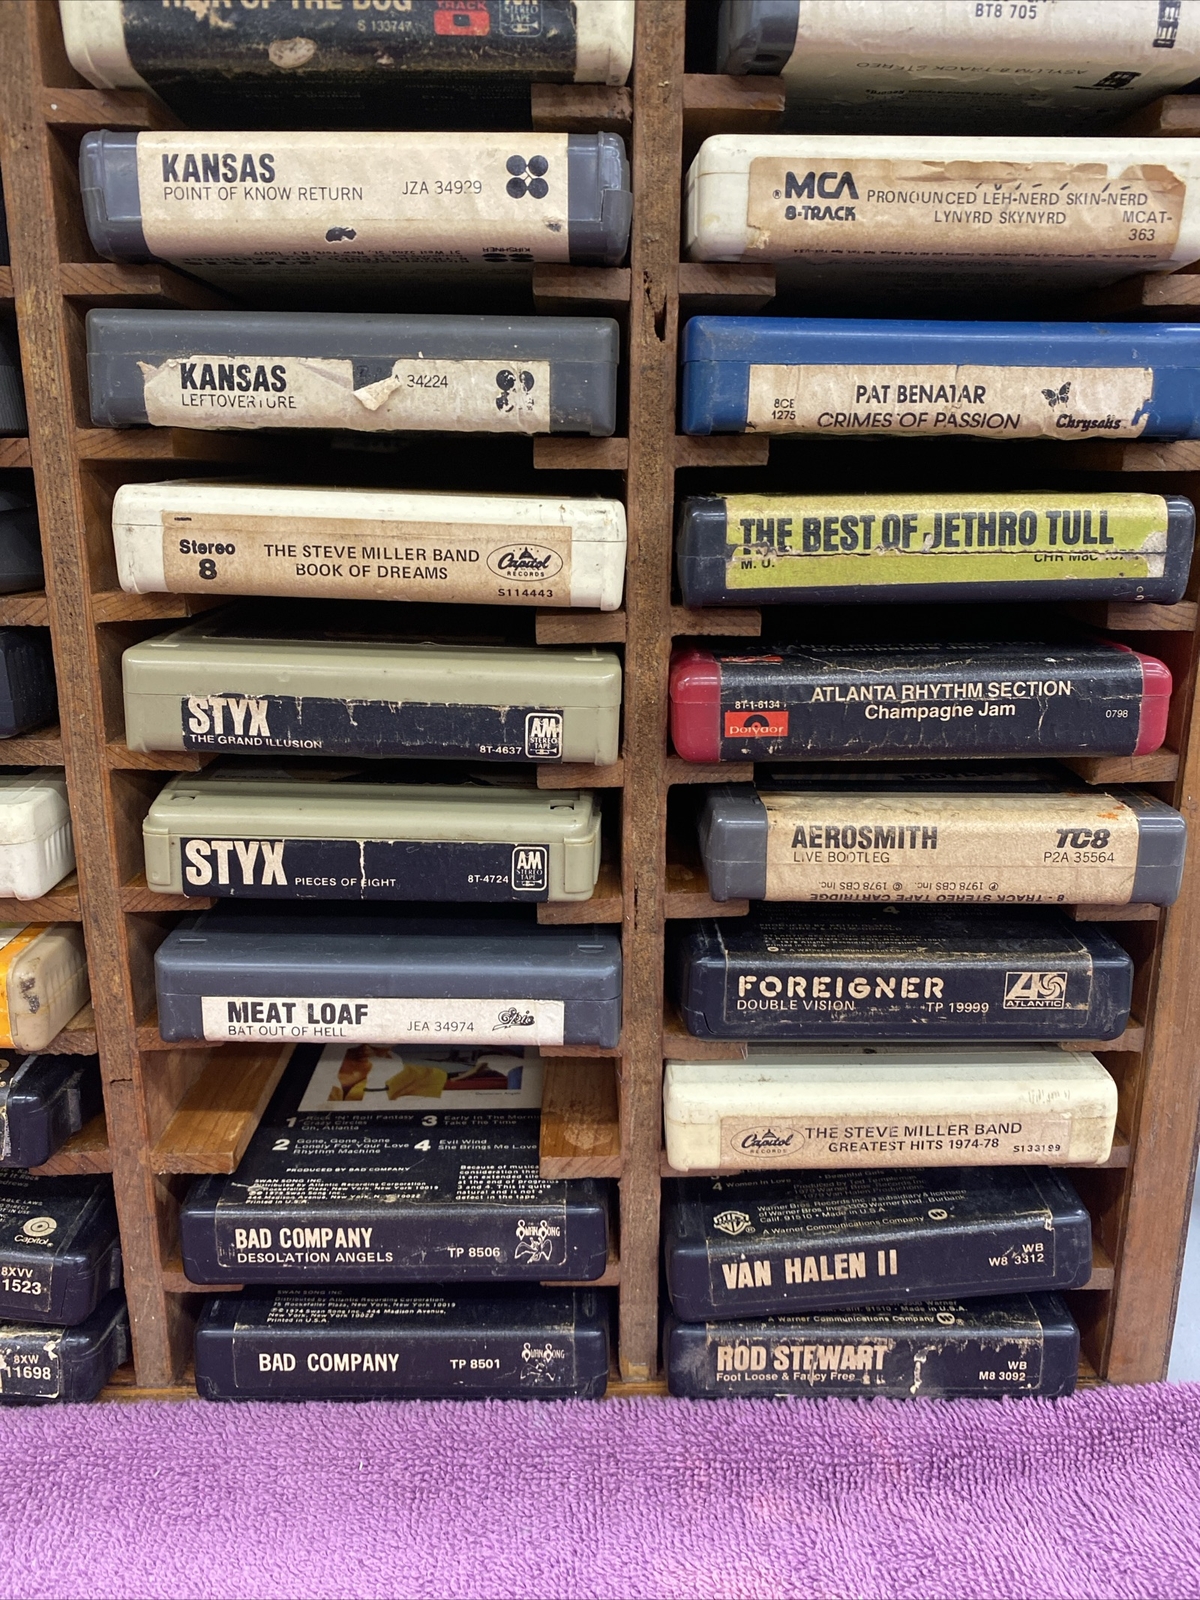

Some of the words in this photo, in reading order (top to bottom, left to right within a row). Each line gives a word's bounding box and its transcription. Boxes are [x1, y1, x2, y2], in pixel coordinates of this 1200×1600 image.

[975, 3, 1002, 18] BT8
[1010, 4, 1037, 19] 705
[357, 21, 366, 32] S
[162, 153, 276, 184] KANSAS
[164, 186, 213, 201] POINT
[217, 187, 238, 201] OF
[245, 187, 292, 201] KNOW
[298, 188, 363, 202] RETURN
[402, 180, 429, 196] JZA
[785, 171, 859, 200] MCA
[867, 189, 976, 205] PRONOUNCED
[785, 206, 856, 222] 8-TRACK
[934, 210, 992, 224] LYNYRD
[999, 211, 1067, 225] SKYNYRD
[1122, 210, 1173, 224] MCAT-
[1128, 228, 1156, 241] 363
[180, 363, 287, 393] KANSAS
[407, 374, 449, 388] 34224
[856, 384, 891, 404] PAT
[773, 398, 795, 408] 8CE
[771, 411, 796, 421] 1275
[817, 411, 893, 428] CRIMES
[899, 412, 928, 428] OF
[933, 412, 1021, 430] PASSION
[740, 518, 793, 555] THE
[803, 515, 875, 552] BEST
[882, 514, 918, 549] OF
[923, 510, 1037, 550] JETHRO
[1045, 510, 1115, 546] TULL
[179, 539, 236, 555] Stereo
[264, 544, 297, 558] THE
[302, 545, 357, 559] STEVE
[361, 546, 427, 561] MILLER
[433, 548, 480, 563] BAND
[497, 552, 552, 570] Capitol
[198, 558, 218, 580] 8
[296, 563, 343, 577] BOOK
[349, 564, 371, 578] OF
[377, 565, 449, 580] DREAMS
[507, 570, 545, 578] RECORDS
[497, 588, 553, 598] S114443
[811, 685, 898, 703] ATLANTA
[900, 682, 983, 702] RHYTHM
[987, 680, 1072, 698] SECTION
[734, 700, 780, 710] 8T-1-6134
[865, 703, 974, 722] Champagne
[978, 701, 1016, 717] Jam
[187, 697, 270, 737] STYX
[1105, 708, 1129, 719] 0798
[190, 734, 215, 745] THE
[217, 735, 263, 748] GRAND
[265, 738, 322, 751] ILLUSION
[479, 745, 522, 755] 8T-4637
[791, 824, 938, 850] AEROSMITH
[1055, 827, 1111, 848] TC8
[185, 839, 288, 886] STYX
[793, 851, 822, 863] LIVE
[828, 851, 890, 863] BOOTLEG
[1043, 851, 1069, 863] P2A
[1074, 851, 1115, 863] 35564
[294, 877, 337, 887] PIECES
[341, 877, 360, 887] OF
[361, 878, 396, 888] EIGHT
[467, 874, 509, 884] 8T-4724
[818, 882, 840, 891] Inc.
[842, 882, 860, 890] CBS
[863, 882, 888, 890] 1978
[914, 882, 935, 890] Inc.
[938, 882, 956, 890] CBS
[957, 882, 984, 890] 1978
[810, 893, 895, 901] CARTRIDGE
[898, 894, 940, 902] TAPE
[944, 894, 994, 902] STEREO
[998, 894, 1043, 902] TRACK
[737, 975, 945, 999] FOREIGNER
[228, 1001, 297, 1024] MEAT
[307, 1002, 369, 1025] LOAF
[736, 999, 799, 1011] DOUBLE
[803, 1000, 856, 1011] VISION
[926, 1002, 944, 1013] TP
[949, 1002, 989, 1014] 19999
[491, 1007, 535, 1032] Epic
[228, 1025, 254, 1036] BAT
[258, 1026, 286, 1037] OUT
[291, 1026, 310, 1037] OF
[314, 1026, 347, 1037] HELL
[407, 1021, 430, 1032] JEA
[434, 1021, 474, 1032] 34974
[286, 1117, 297, 1128] 1
[421, 1115, 438, 1126] 3
[805, 1126, 840, 1139] THE
[843, 1125, 899, 1139] STEVE
[904, 1124, 969, 1138] MILLER
[974, 1121, 1023, 1136] BAND
[272, 1138, 291, 1151] 2
[414, 1139, 432, 1151] 4
[741, 1134, 793, 1150] Capitol
[828, 1139, 905, 1153] GREATEST
[909, 1139, 944, 1151] HITS
[948, 1138, 1000, 1151] 1974-78
[1012, 1144, 1062, 1153] S133199
[771, 1226, 804, 1234] Warner
[806, 1220, 881, 1232] Communications
[882, 1215, 925, 1225] Company
[14, 1234, 50, 1245] Capitol
[235, 1228, 272, 1250] BAD
[279, 1227, 373, 1249] COMPANY
[1021, 1243, 1044, 1252] WB
[237, 1252, 331, 1264] DESOLATION
[334, 1252, 393, 1263] ANGELS
[448, 1247, 464, 1258] TP
[468, 1247, 501, 1258] 8506
[988, 1255, 1009, 1267] W8
[1013, 1253, 1045, 1265] 3312
[722, 1258, 772, 1289] VAN
[785, 1252, 867, 1285] HALEN
[877, 1249, 898, 1276] II
[892, 1315, 935, 1323] Company
[14, 1354, 39, 1364] 8XW
[259, 1353, 296, 1371] BAD
[307, 1353, 400, 1372] COMPANY
[450, 1359, 466, 1370] TP
[469, 1359, 501, 1370] 8501
[716, 1346, 767, 1371] ROD
[773, 1345, 889, 1371] STEWART
[1007, 1361, 1028, 1370] WB
[6, 1366, 51, 1380] 11698
[716, 1372, 740, 1382] Foot
[745, 1372, 779, 1381] Loose
[781, 1372, 790, 1381] &
[829, 1372, 856, 1381] Free
[979, 1371, 996, 1381] M8
[999, 1371, 1026, 1381] 3092
